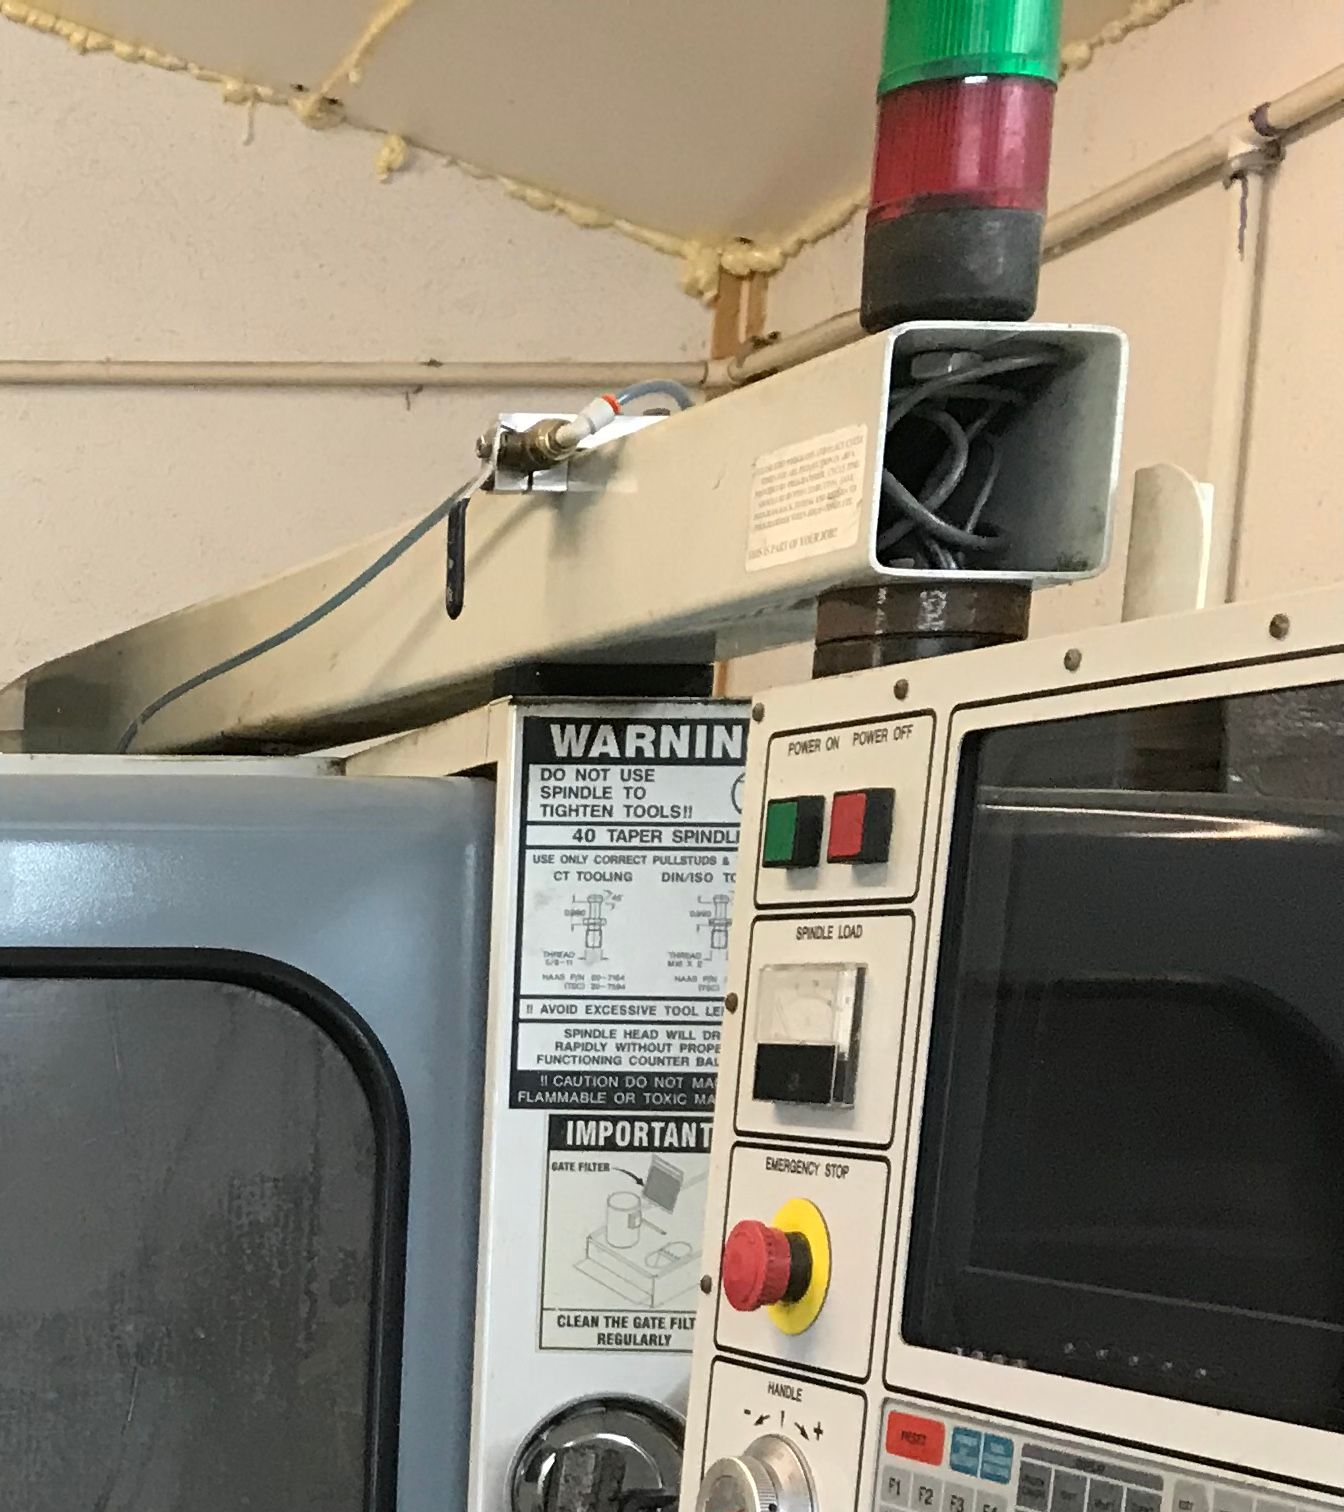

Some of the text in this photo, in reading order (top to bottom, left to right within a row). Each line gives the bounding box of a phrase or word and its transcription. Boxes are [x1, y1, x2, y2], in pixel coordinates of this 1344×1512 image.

[788, 724, 914, 756] POWER ON POWER OFF
[540, 768, 655, 782] DO NOT USE
[540, 786, 646, 800] SPINDLE TO
[540, 804, 692, 819] TIGHTEN TOOLS!!
[572, 829, 740, 844] 40 TAPER SPINDL
[533, 854, 554, 864] USE
[560, 855, 587, 865] ONLY
[594, 855, 647, 865] CORRECT
[653, 856, 716, 866] PULLSTUDS
[553, 871, 632, 882] CT TOOLING
[662, 872, 713, 883] DIN/ISO
[796, 924, 862, 940] SPINDLE LOAD
[540, 1004, 578, 1014] AVOID
[585, 1005, 657, 1016] EXCESSIVE
[664, 1005, 699, 1017] TOOL
[564, 1028, 617, 1039] SPINDLE
[623, 1029, 659, 1040] HEAD
[666, 1030, 696, 1041] WILL
[555, 1041, 608, 1052] RAPIDLY
[615, 1042, 672, 1053] WITHOUT
[536, 1054, 622, 1066] FUNCTIONING
[629, 1055, 689, 1067] COUNTER
[552, 1075, 619, 1088] CAUTION
[625, 1075, 648, 1088] DO
[654, 1076, 683, 1089] NOT
[517, 1090, 607, 1104] FLAMMABLE
[613, 1092, 636, 1105] OR
[643, 1092, 688, 1105] TOXIC
[566, 1120, 712, 1148] IMPORTANT
[551, 1162, 610, 1173] GATE FILTER
[766, 1156, 850, 1179] EMERGENCY STOP
[557, 1314, 599, 1328] CLEAN
[604, 1315, 628, 1329] THE
[633, 1316, 666, 1330] GATE
[596, 1332, 672, 1346] REGULARLY
[768, 1381, 802, 1402] HANDLE
[889, 1477, 901, 1496] F1
[919, 1486, 934, 1505] F2
